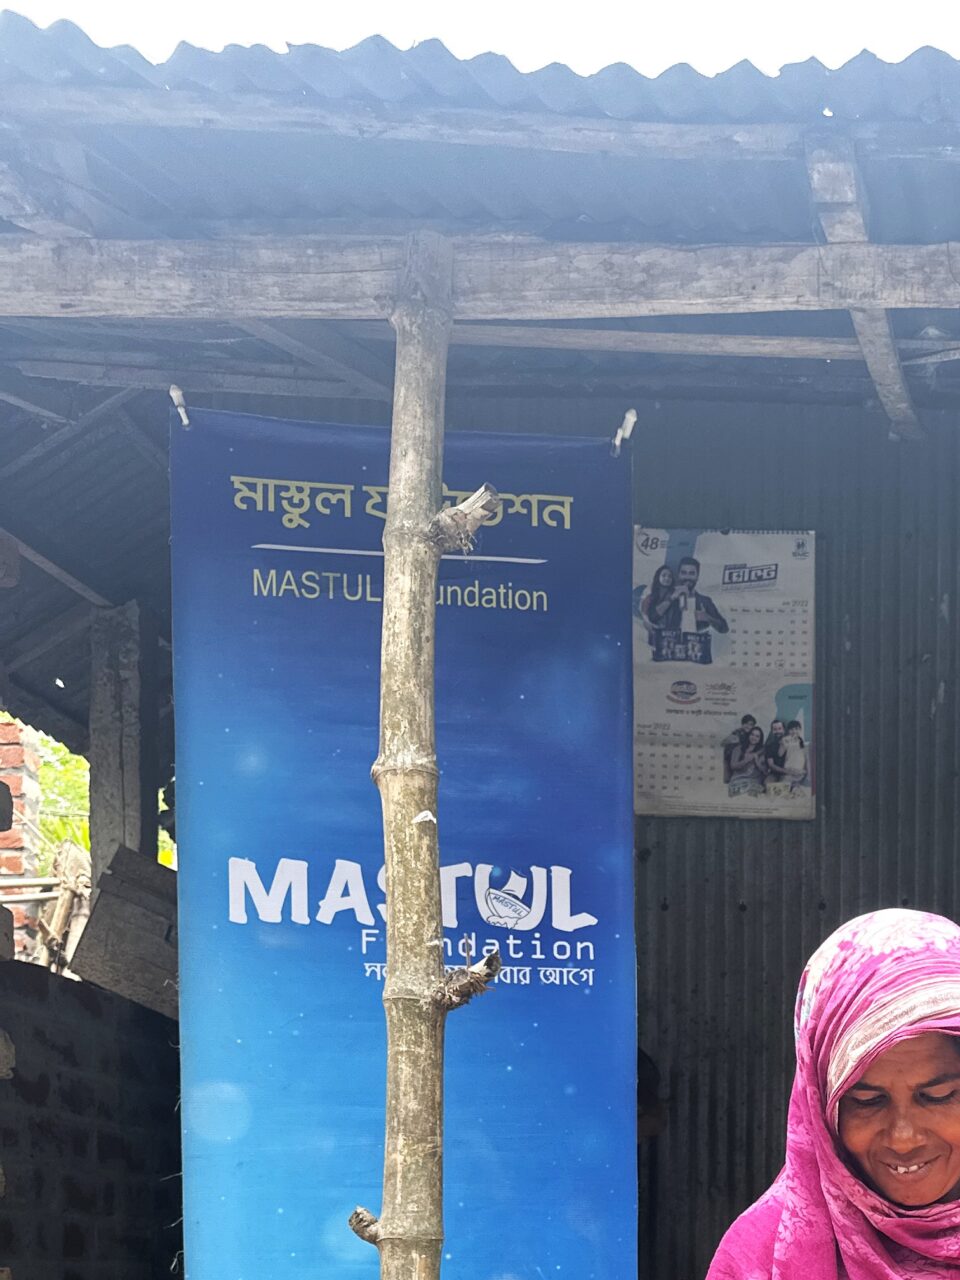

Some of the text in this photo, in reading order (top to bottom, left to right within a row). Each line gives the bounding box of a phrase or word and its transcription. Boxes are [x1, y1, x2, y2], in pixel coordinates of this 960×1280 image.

[230, 475, 354, 530] মাস্তুল
[640, 537, 660, 550] 48
[252, 568, 548, 612] MASTUL undation
[228, 857, 598, 932] MATUL
[362, 929, 595, 960] Fndation
[538, 966, 595, 986] আগে
